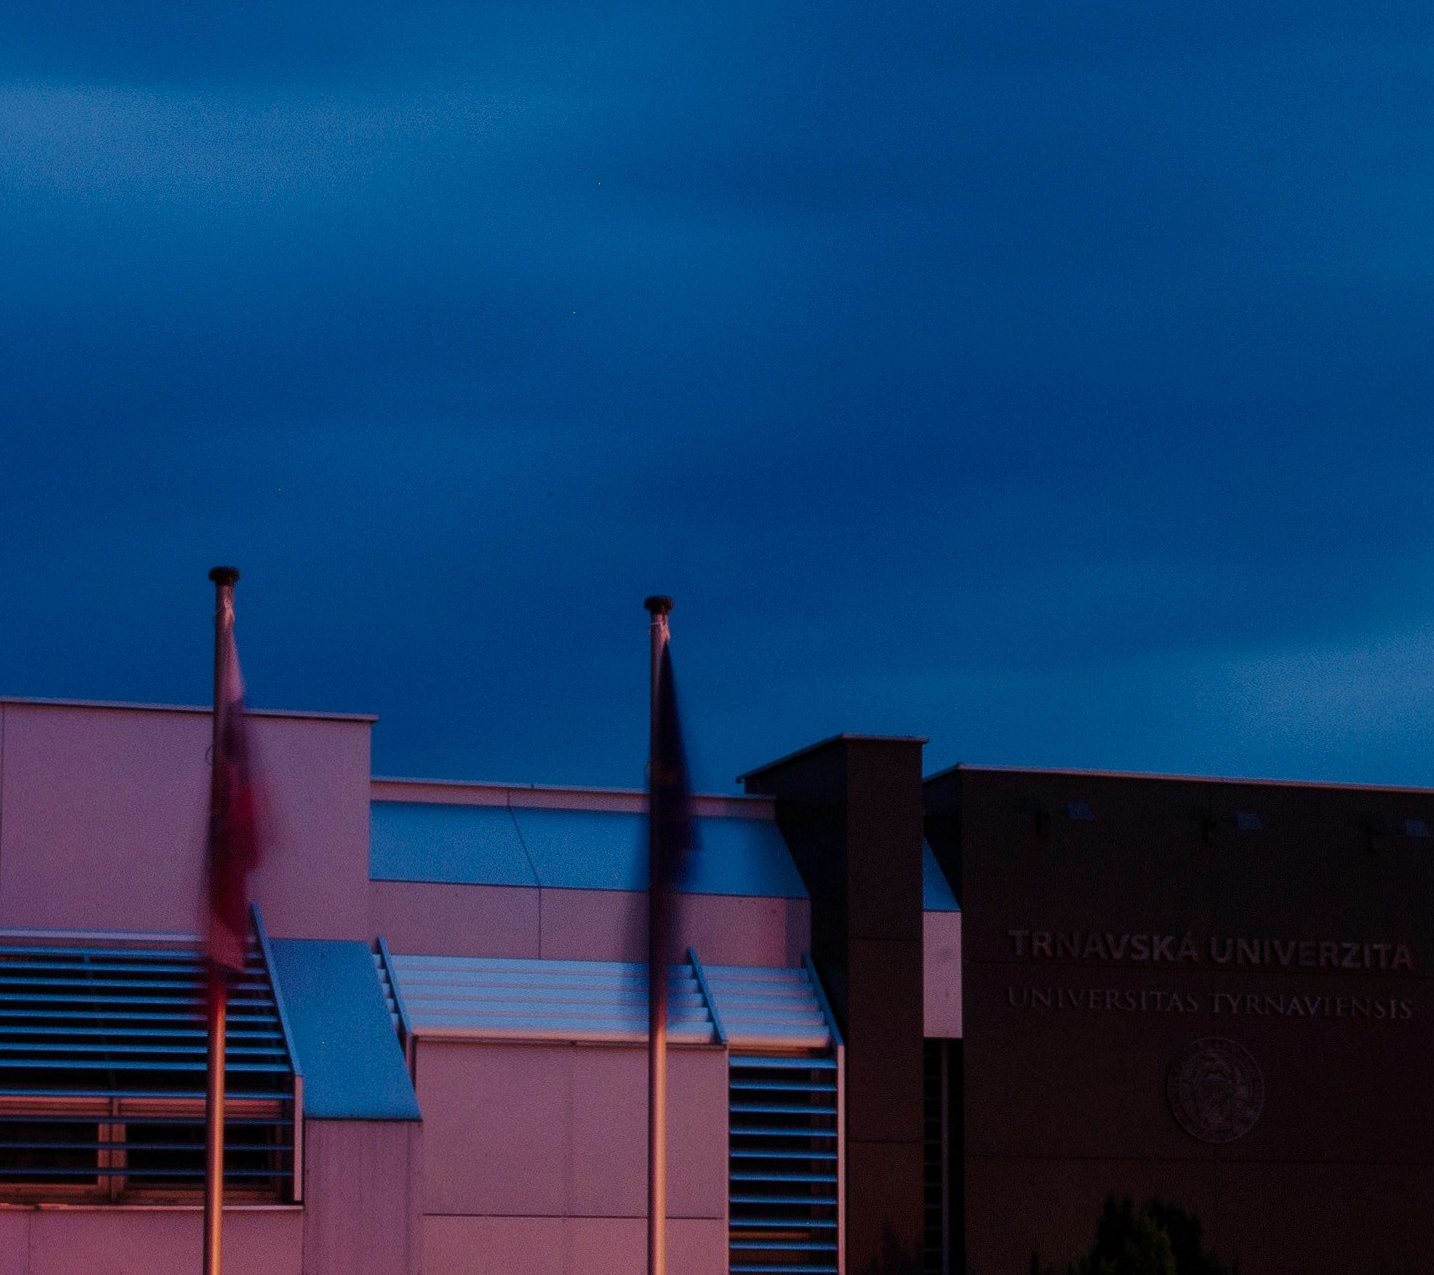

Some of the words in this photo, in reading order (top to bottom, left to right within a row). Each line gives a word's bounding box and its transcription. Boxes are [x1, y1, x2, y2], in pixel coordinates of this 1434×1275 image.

[1008, 929, 1199, 963] TRNAVSKÁ
[1211, 936, 1414, 971] UNIVERZITA
[1007, 986, 1199, 1013] UNIVERSITAS
[1211, 992, 1413, 1020] TYRNAVIENSIS
